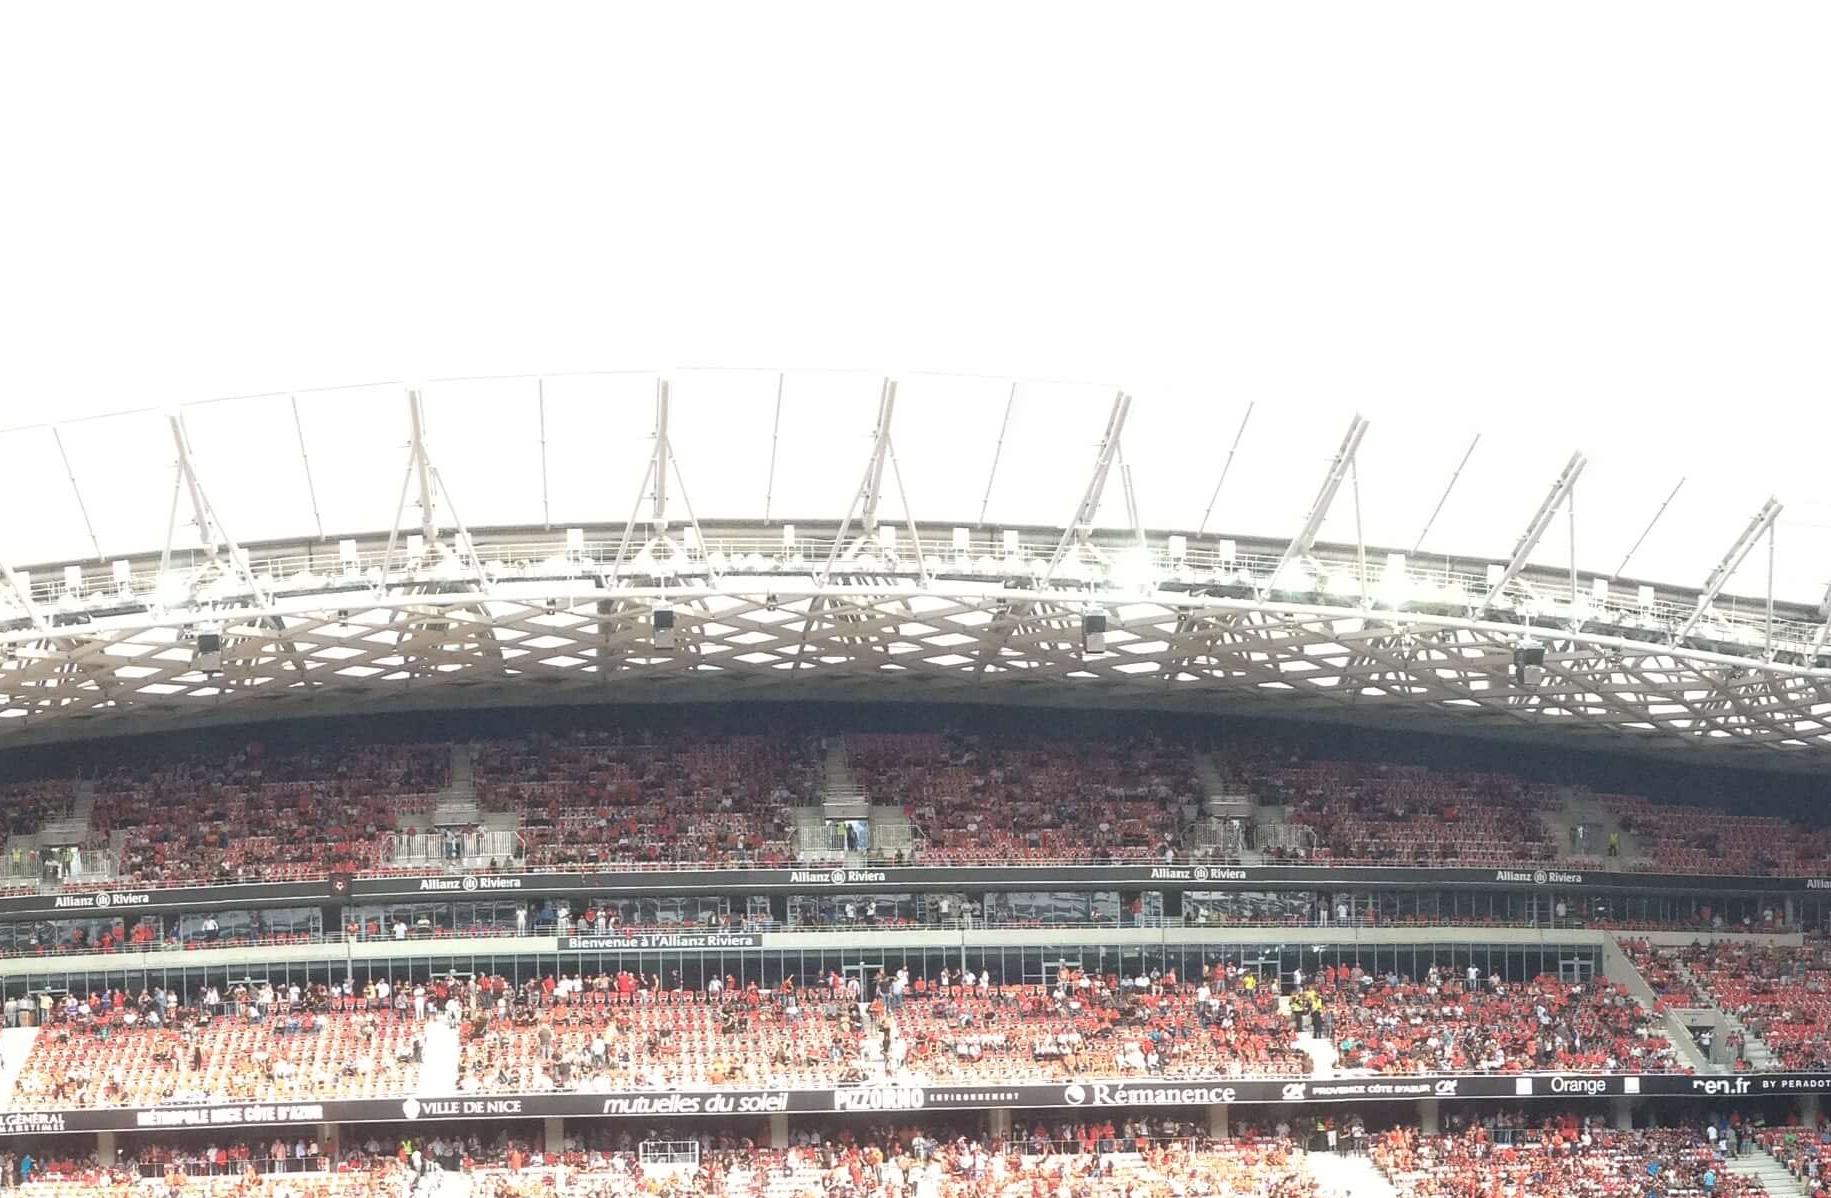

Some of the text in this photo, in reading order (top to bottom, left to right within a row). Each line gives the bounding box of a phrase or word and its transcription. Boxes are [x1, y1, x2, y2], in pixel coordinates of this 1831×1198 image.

[790, 870, 886, 882] Allianz Riviera
[1151, 867, 1247, 880] Allianz Riviera
[1495, 870, 1582, 884] Allianz Riviera
[420, 875, 521, 891] Allianz Riviera
[55, 892, 150, 908] Allianz Riviera
[569, 935, 753, 948] Bienvenue à l'Allianz Riviera
[1312, 1086, 1366, 1096] PROVENCE
[1551, 1076, 1606, 1095] Orange
[1762, 1080, 1778, 1088] BY
[1092, 1083, 1237, 1104] Rémanence
[423, 1100, 522, 1114] VILLE DE NICE
[603, 1092, 789, 1114] mutuelles du soleil
[4, 1111, 65, 1126] GÉNÉRAL
